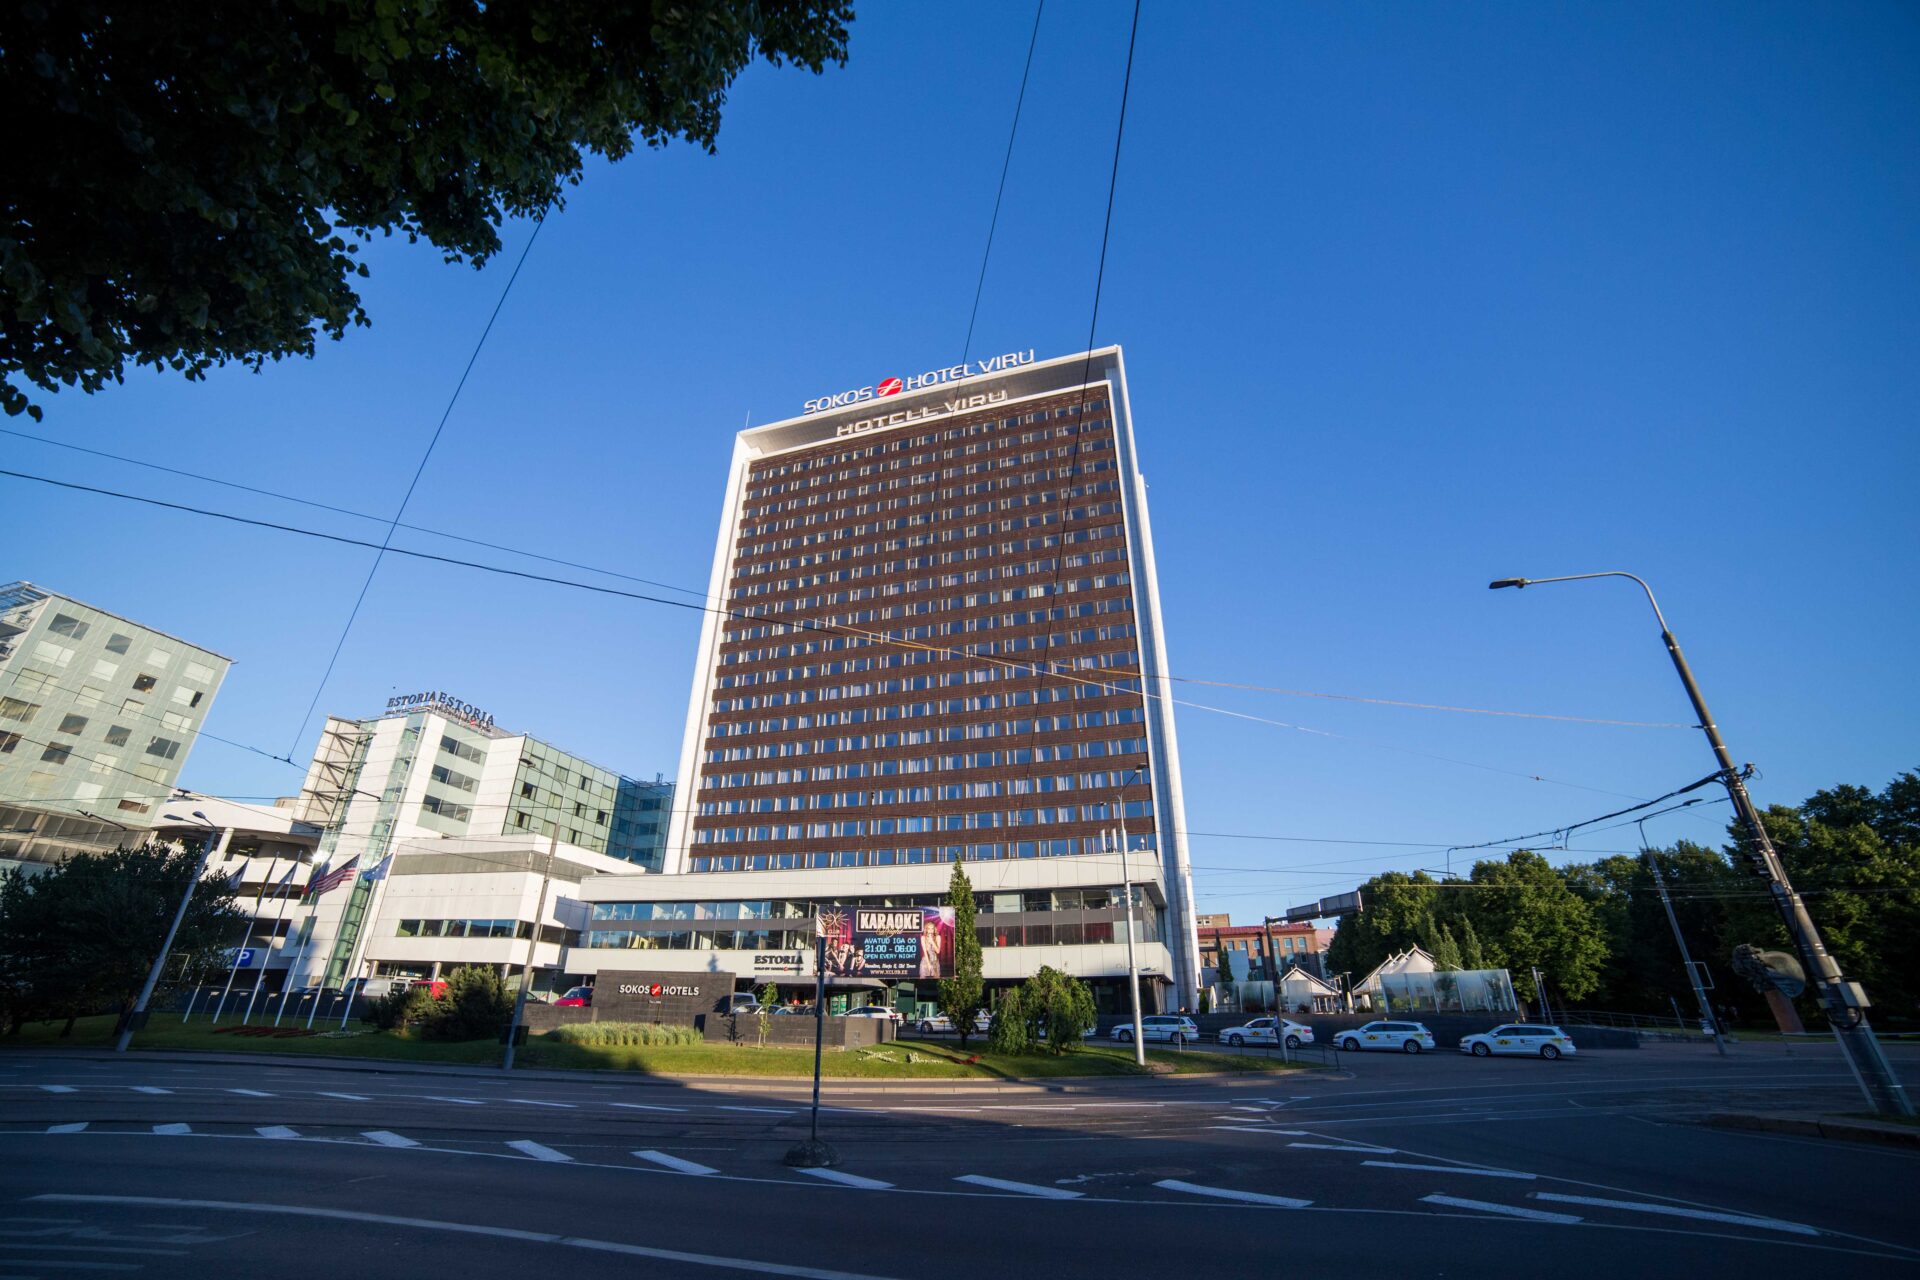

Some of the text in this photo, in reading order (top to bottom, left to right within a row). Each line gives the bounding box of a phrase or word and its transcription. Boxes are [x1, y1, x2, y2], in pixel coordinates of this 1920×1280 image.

[803, 348, 1035, 415] SOKOS HOTEL VIRU
[944, 388, 1008, 413] VIRU
[387, 690, 436, 708] ESTORIA
[438, 691, 495, 727] ESTORIA
[860, 912, 920, 930] KARAOKE
[864, 937, 890, 945] AVATUD
[892, 937, 906, 945] IGA
[864, 944, 887, 953] 21:00
[894, 944, 917, 953] 06:00
[237, 951, 250, 964] P
[754, 955, 804, 964] ESTORIA
[619, 984, 700, 996] SOKOS HOTELS
